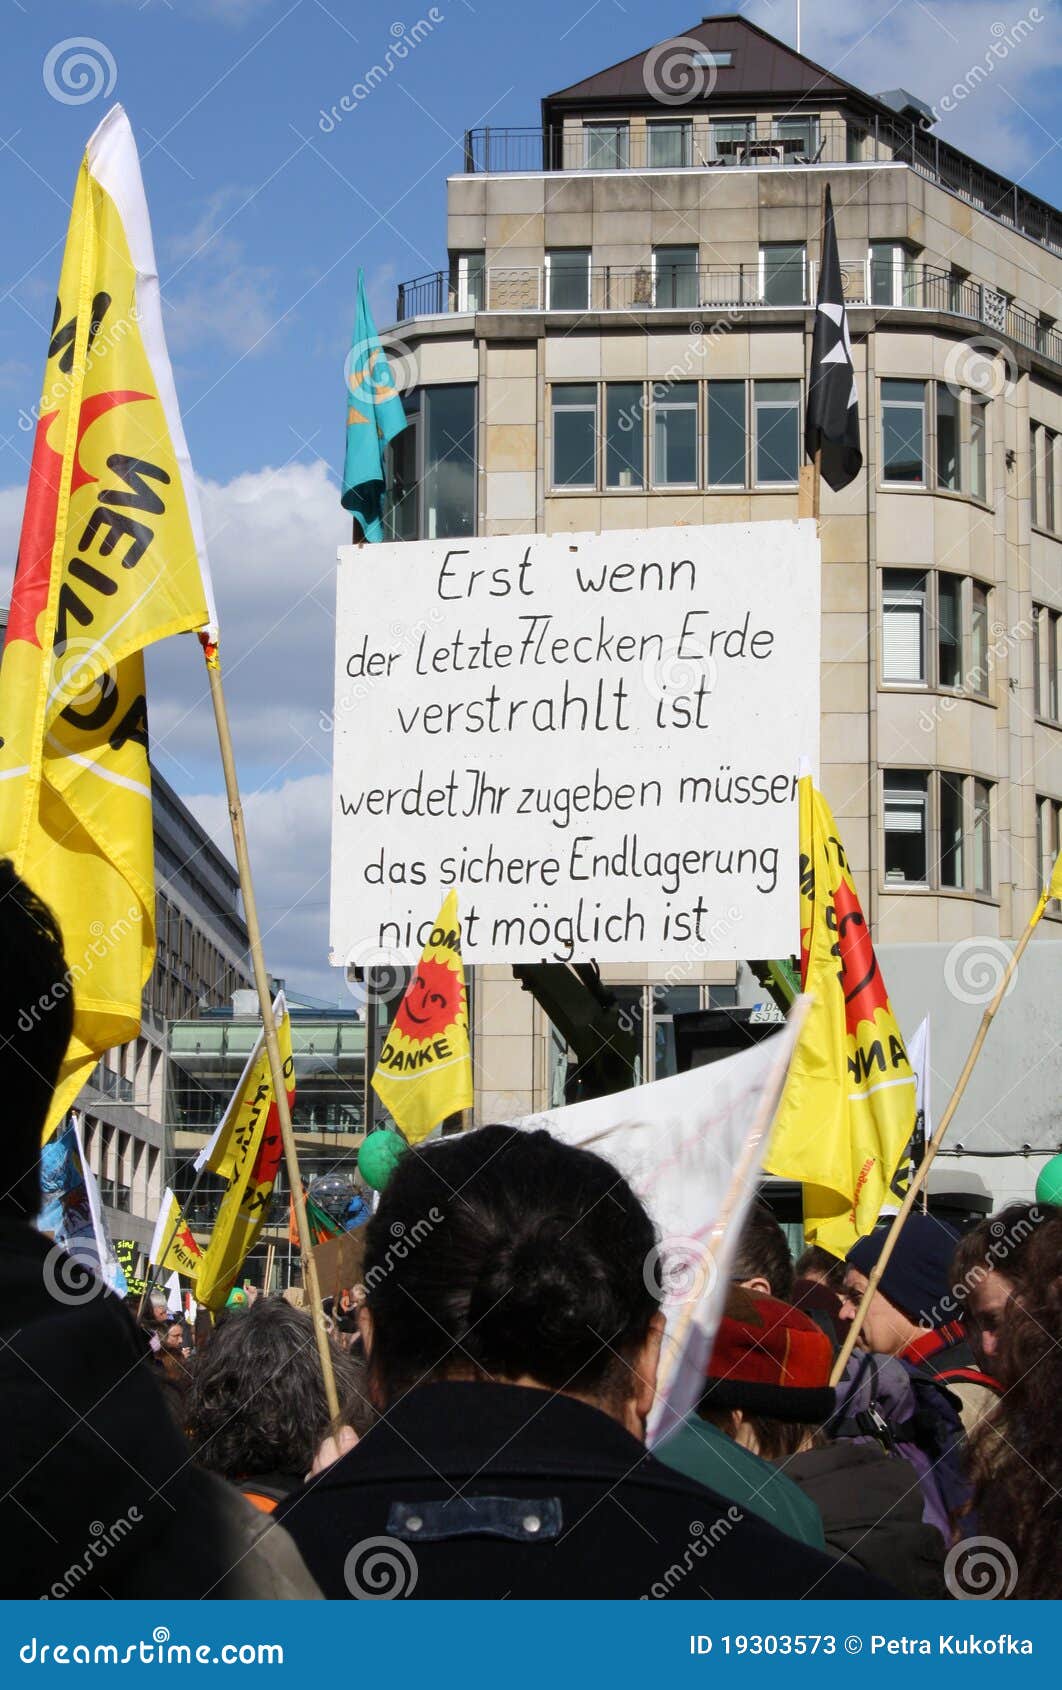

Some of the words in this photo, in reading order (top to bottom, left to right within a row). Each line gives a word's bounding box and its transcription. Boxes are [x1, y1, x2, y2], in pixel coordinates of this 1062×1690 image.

[437, 546, 534, 600] Erst
[576, 560, 696, 593] wenn
[346, 634, 401, 678] der
[416, 628, 513, 676] letzte
[519, 614, 663, 665] Flecken
[678, 610, 774, 660] Erde
[397, 677, 630, 734] verstrahlt
[656, 674, 712, 730] ist
[340, 769, 460, 817] werdet
[516, 768, 661, 828] zugeben
[363, 847, 427, 886] das
[440, 844, 560, 886] sichere
[569, 834, 779, 894] Endlagerung
[379, 904, 481, 949] nict
[492, 897, 645, 960] möglich
[663, 895, 709, 942] ist
[379, 1038, 453, 1072] DANKE
[172, 1244, 196, 1270] NEIN
